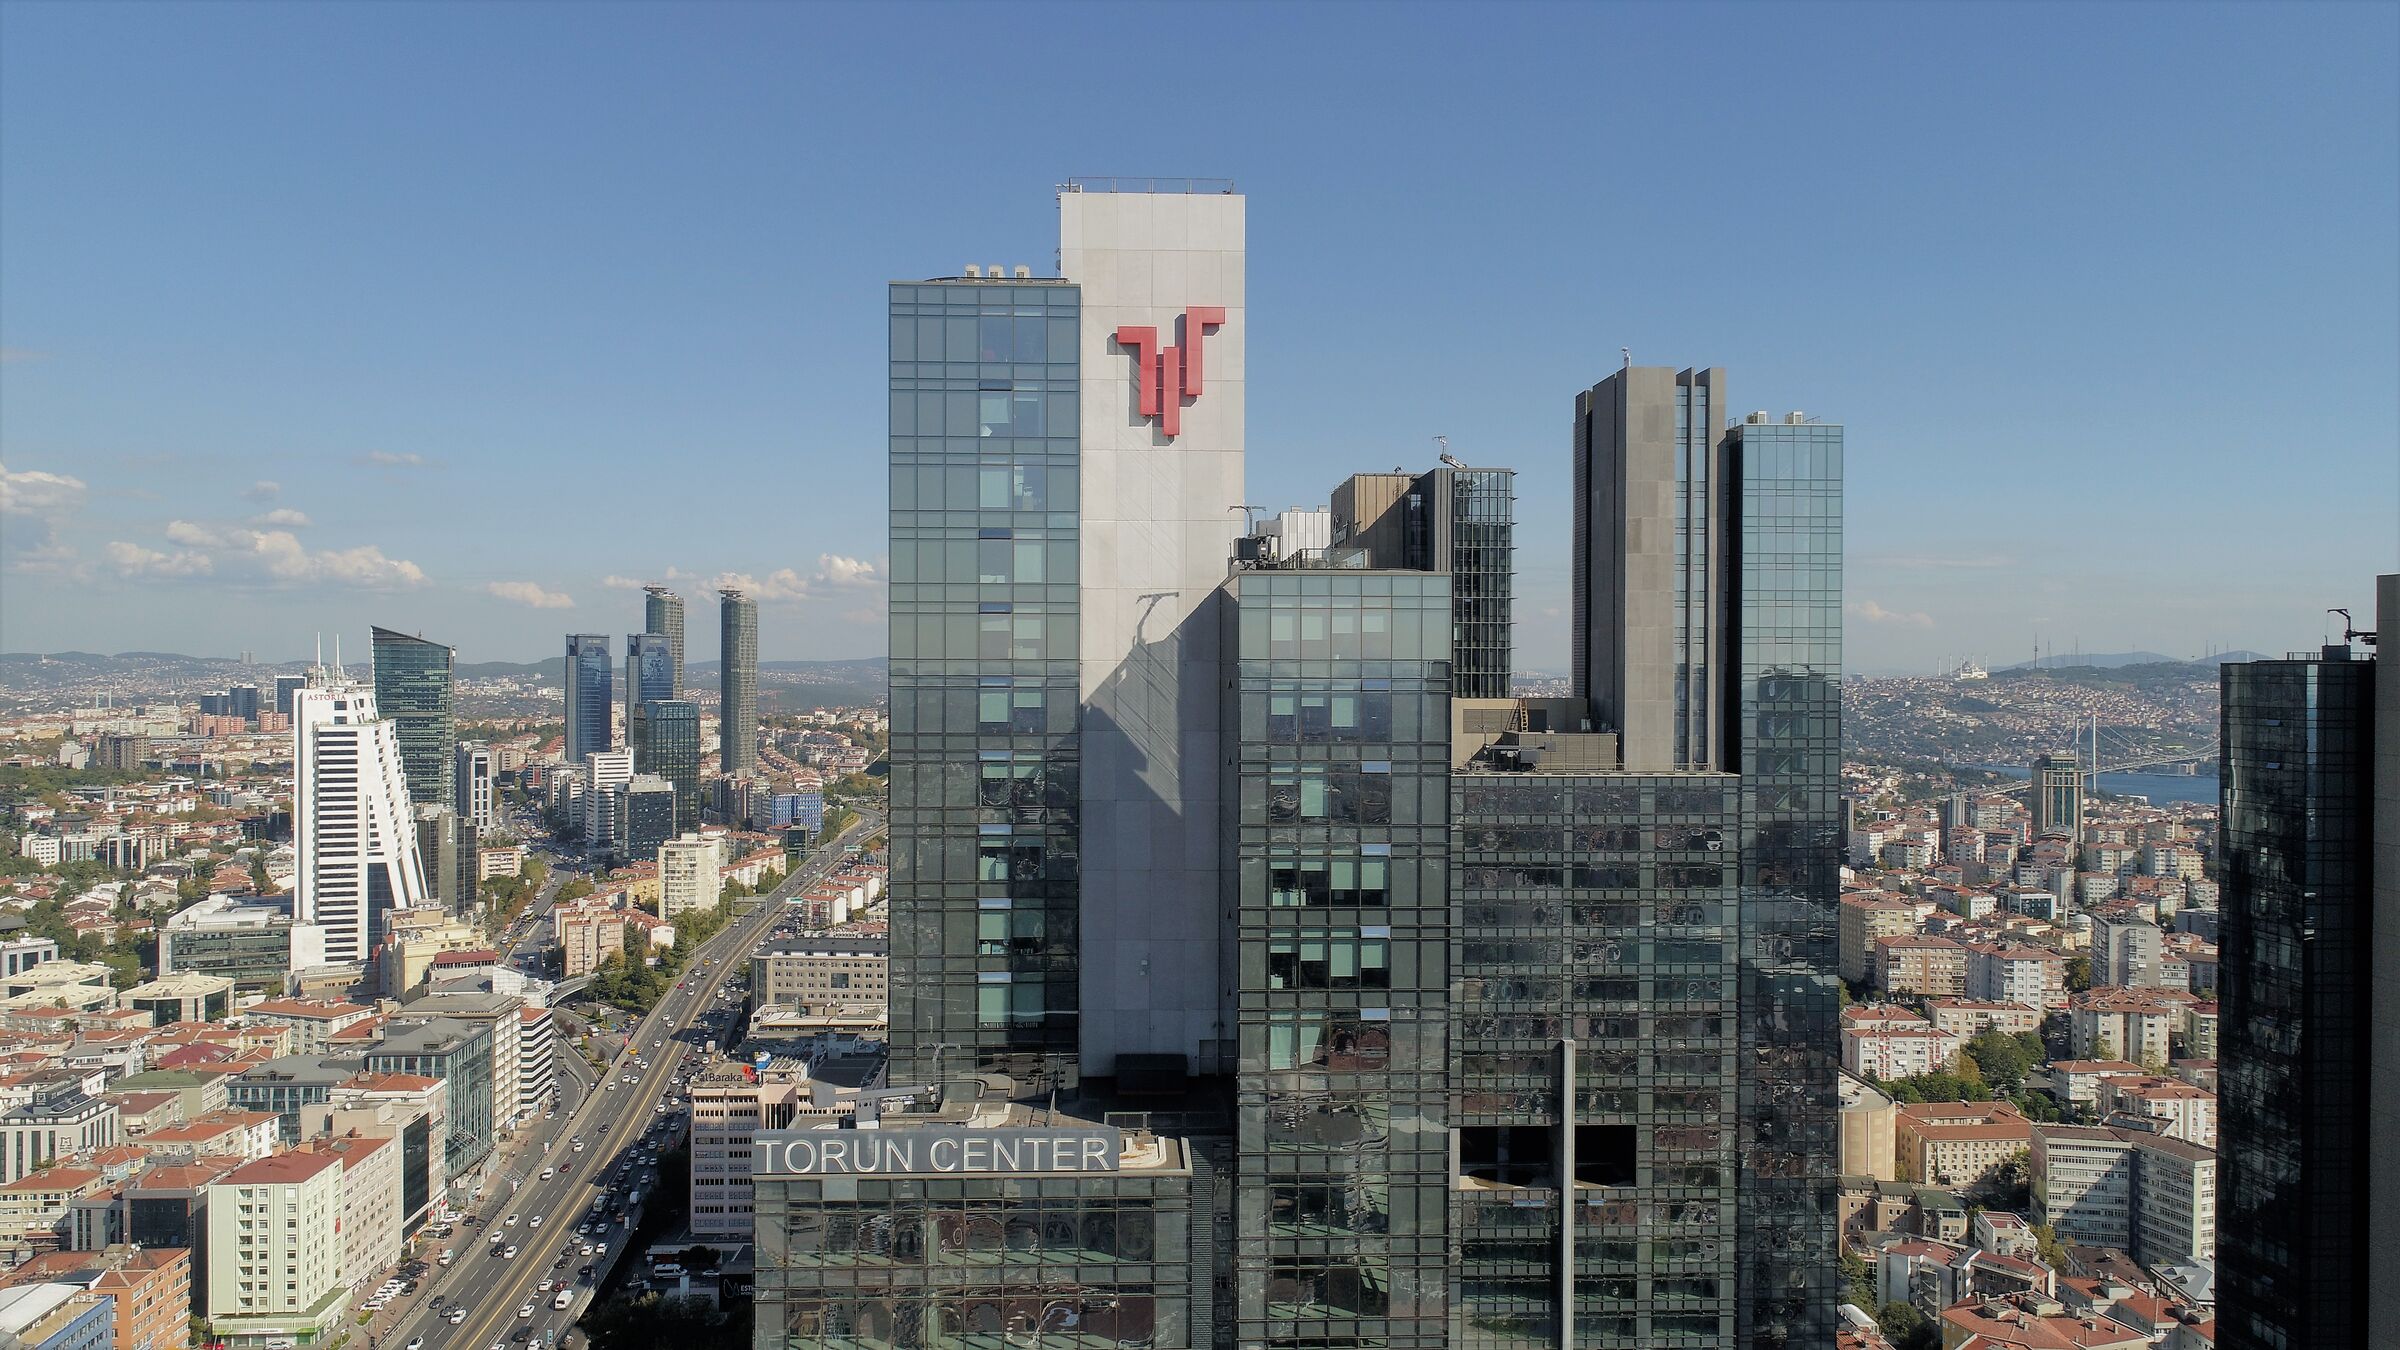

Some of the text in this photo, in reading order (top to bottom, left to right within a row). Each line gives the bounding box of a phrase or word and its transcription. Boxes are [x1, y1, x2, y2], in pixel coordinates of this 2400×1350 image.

[700, 1073, 742, 1082] alBaraka
[755, 1137, 1111, 1173] TORUN CENTER
